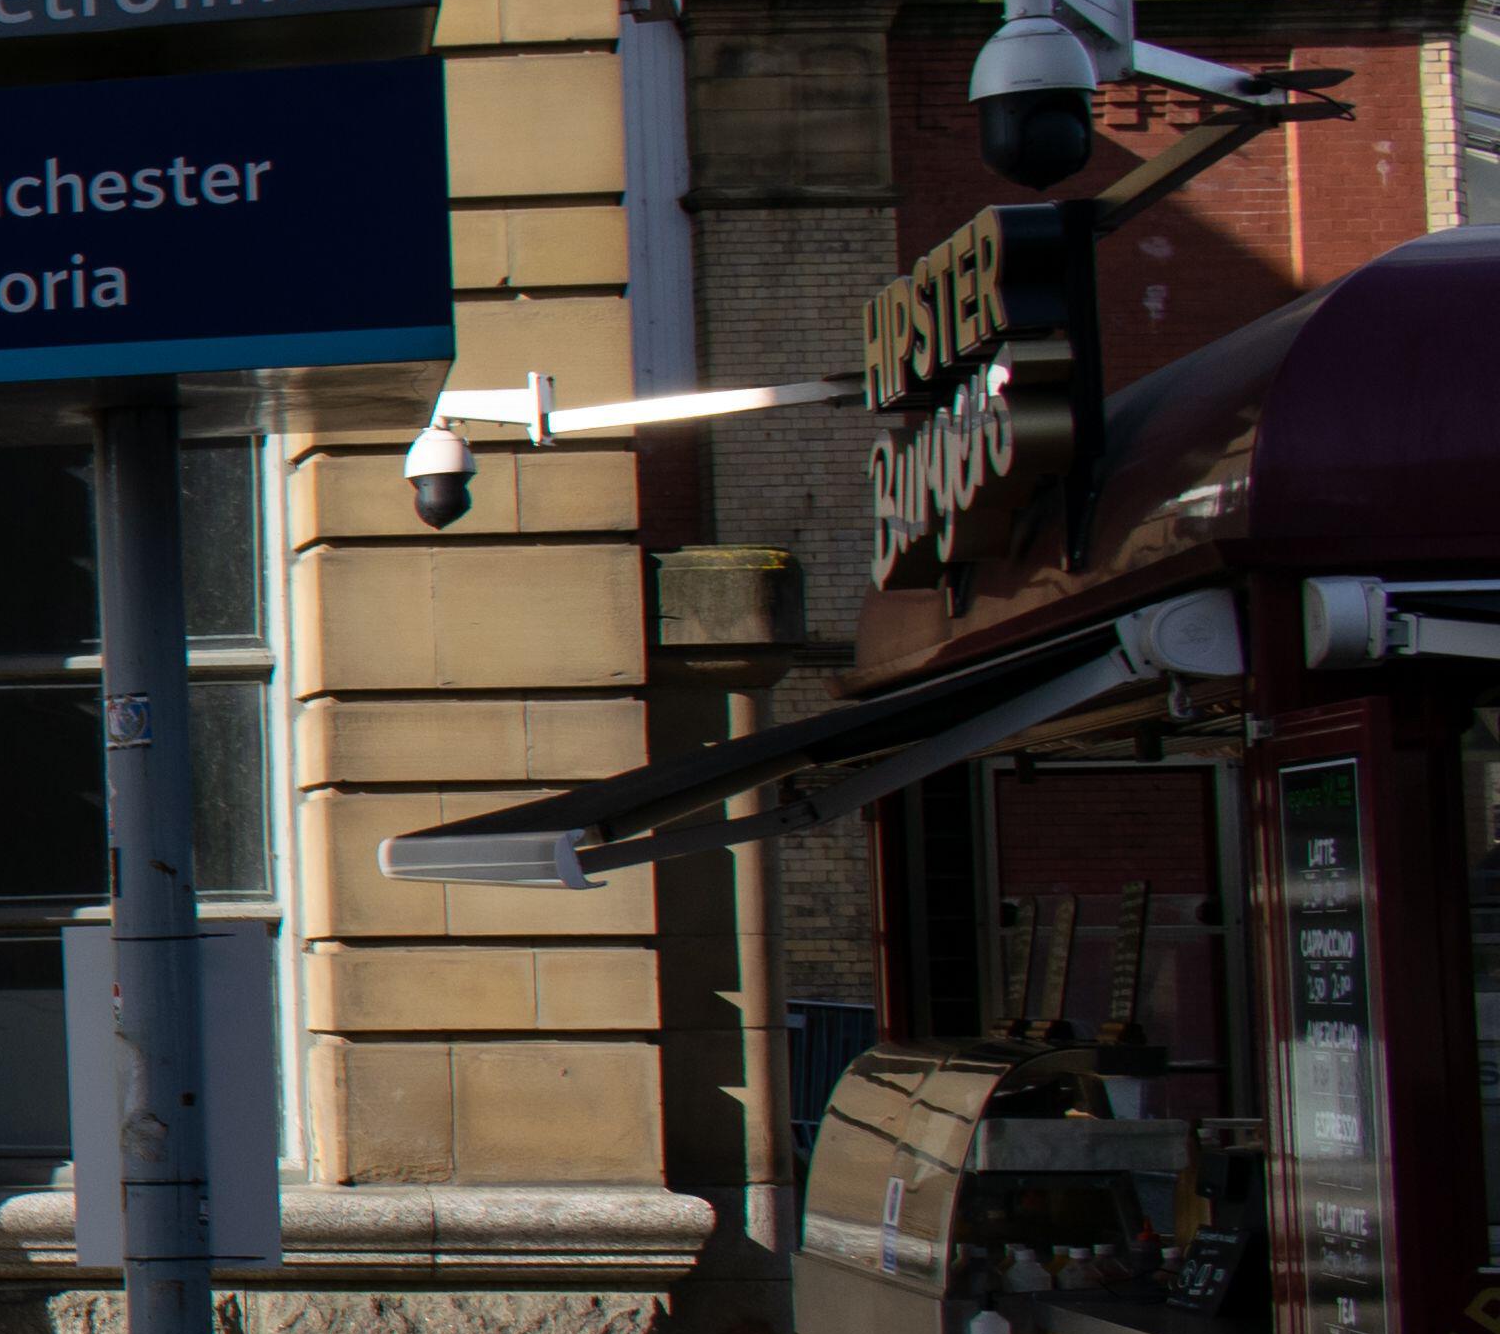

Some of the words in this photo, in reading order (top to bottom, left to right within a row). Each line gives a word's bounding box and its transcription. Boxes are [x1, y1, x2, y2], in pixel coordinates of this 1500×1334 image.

[863, 205, 1009, 410] HIPSTER
[868, 341, 1015, 591] Burgers
[1307, 838, 1339, 867] LATTE
[1300, 928, 1356, 959] CAPPUCCINO
[1336, 1296, 1357, 1325] TEA
